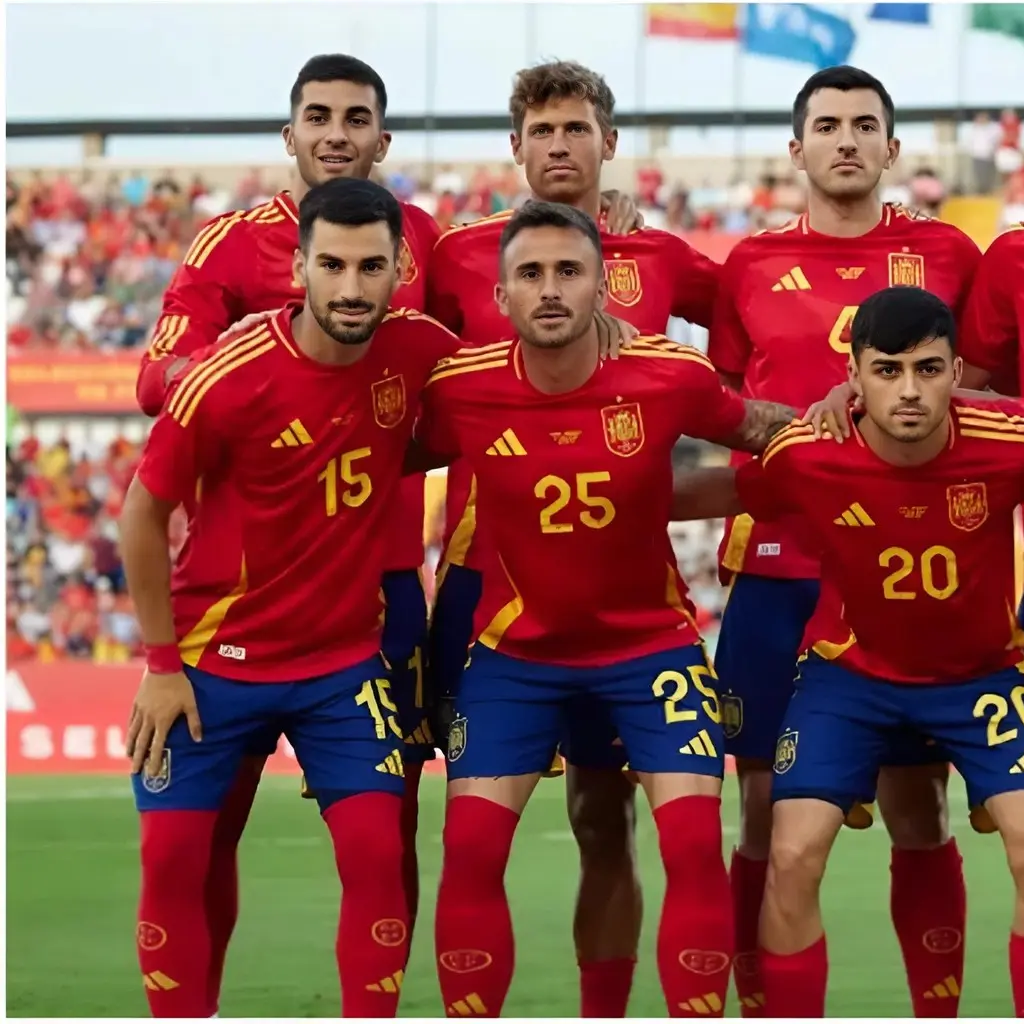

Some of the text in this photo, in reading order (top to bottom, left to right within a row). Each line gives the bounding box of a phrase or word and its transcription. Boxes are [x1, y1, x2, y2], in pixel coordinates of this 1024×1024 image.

[317, 447, 373, 516] 15
[534, 471, 616, 533] 25
[878, 545, 959, 601] 20
[652, 665, 721, 724] 25
